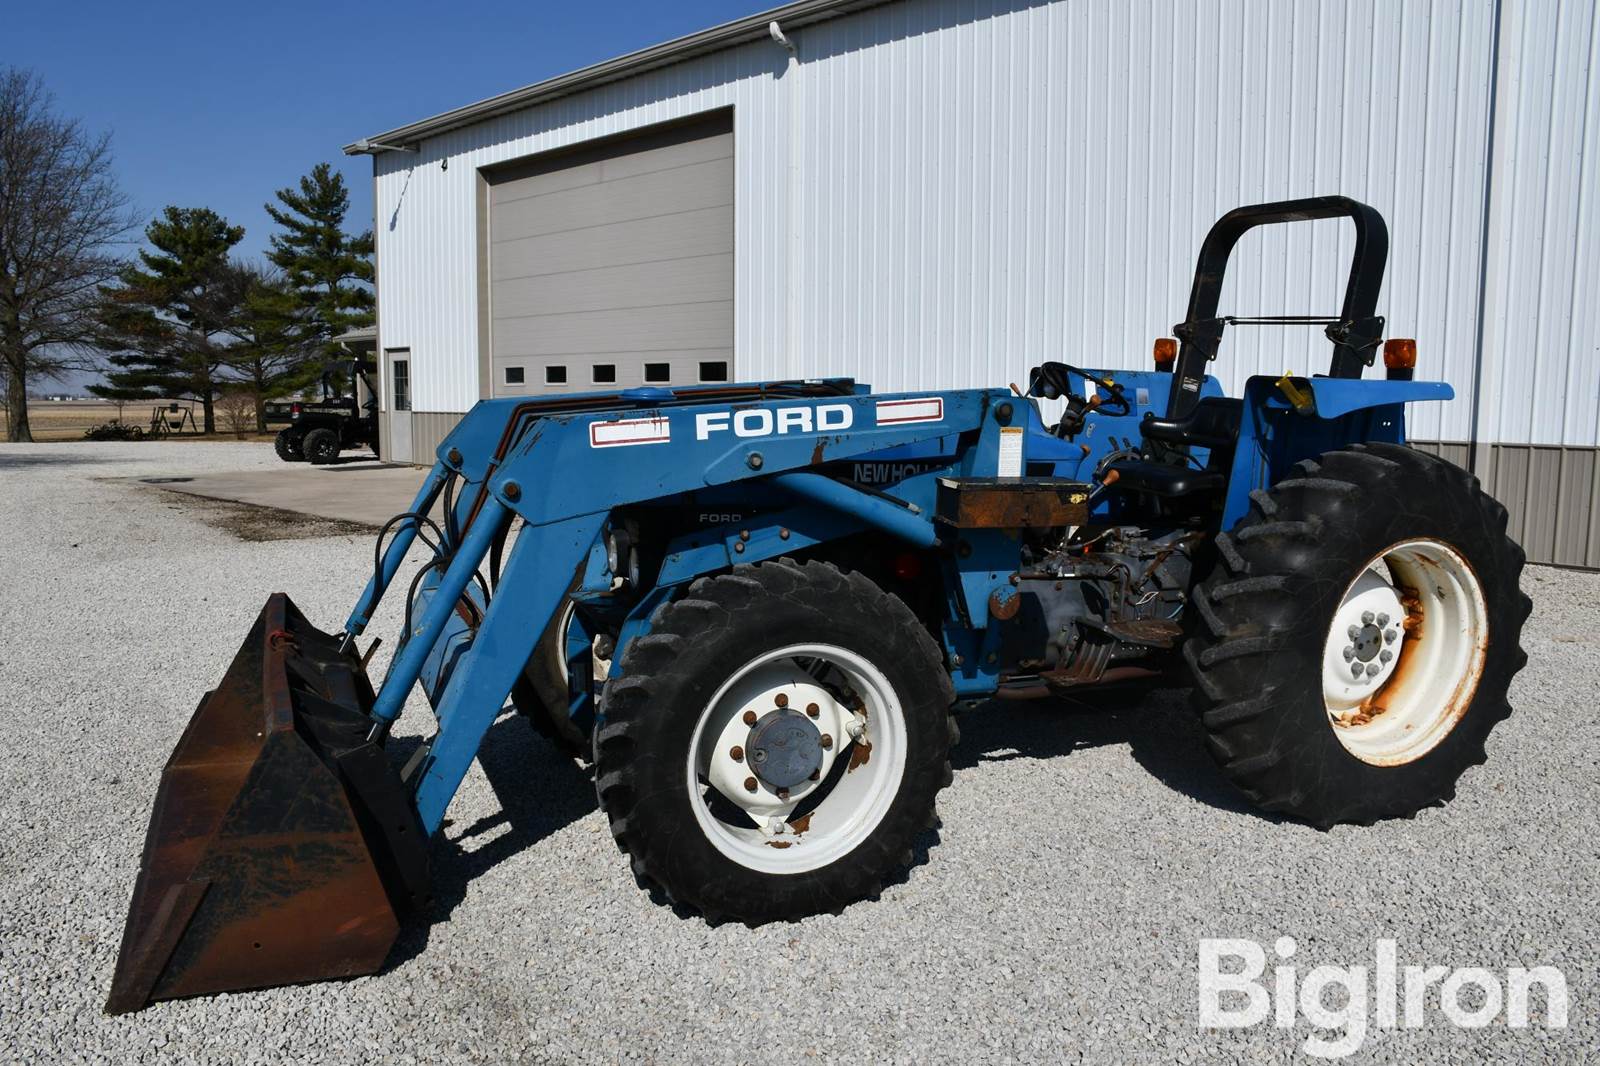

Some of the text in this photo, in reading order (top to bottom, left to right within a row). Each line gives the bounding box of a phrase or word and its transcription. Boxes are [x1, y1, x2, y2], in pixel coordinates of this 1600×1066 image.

[695, 404, 854, 441] FORD
[853, 463, 890, 483] NEW
[699, 513, 742, 523] FORD
